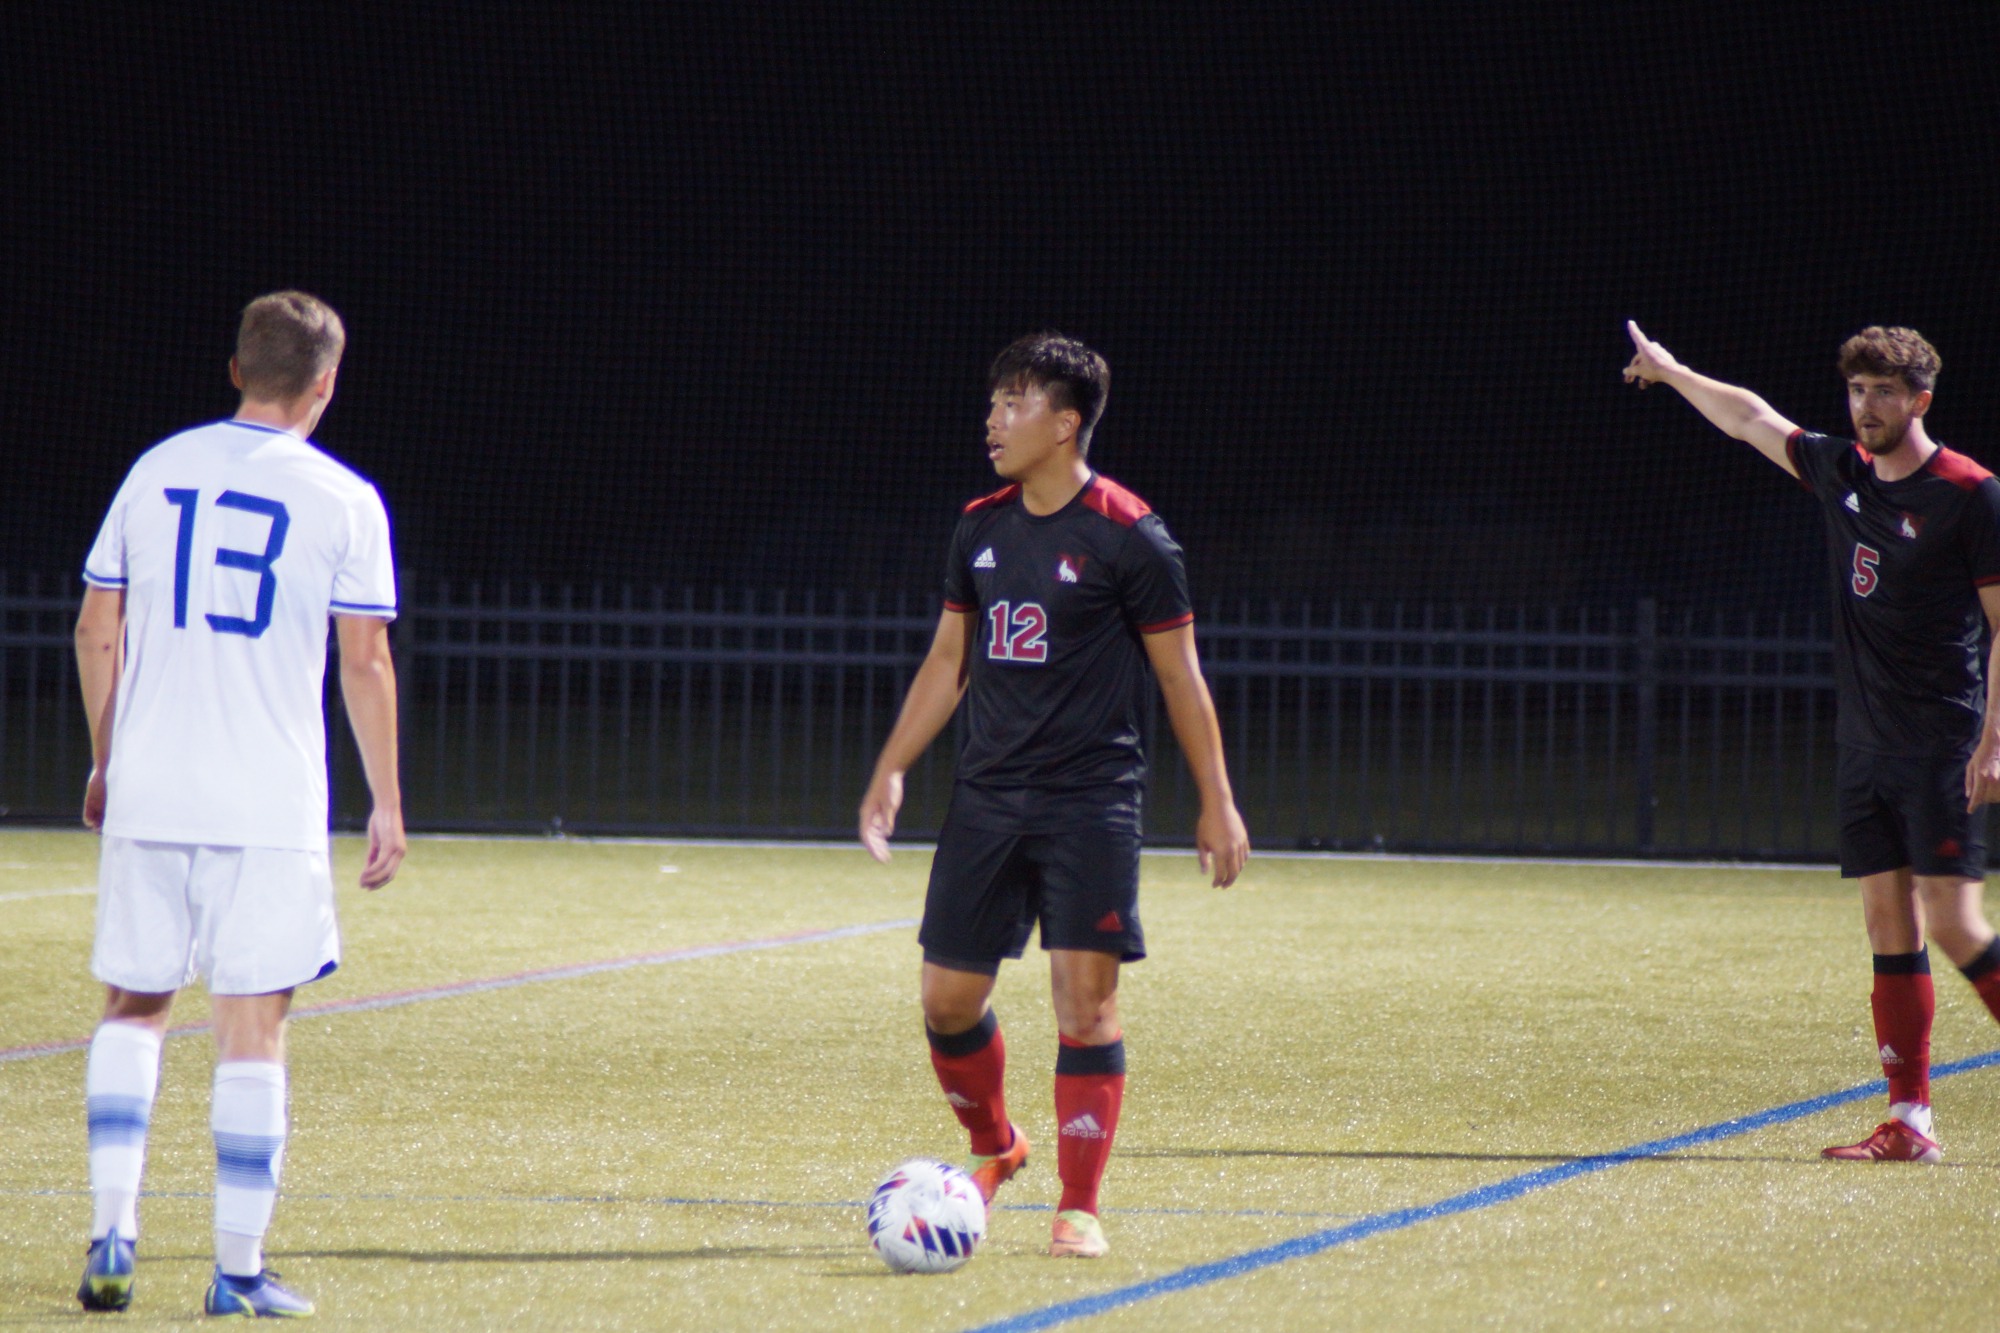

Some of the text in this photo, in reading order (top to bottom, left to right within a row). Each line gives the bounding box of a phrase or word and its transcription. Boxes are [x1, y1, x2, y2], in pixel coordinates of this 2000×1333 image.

[163, 487, 291, 639] 13
[1851, 542, 1880, 598] 5
[988, 600, 1048, 663] 12
[1061, 1127, 1107, 1139] adidas
